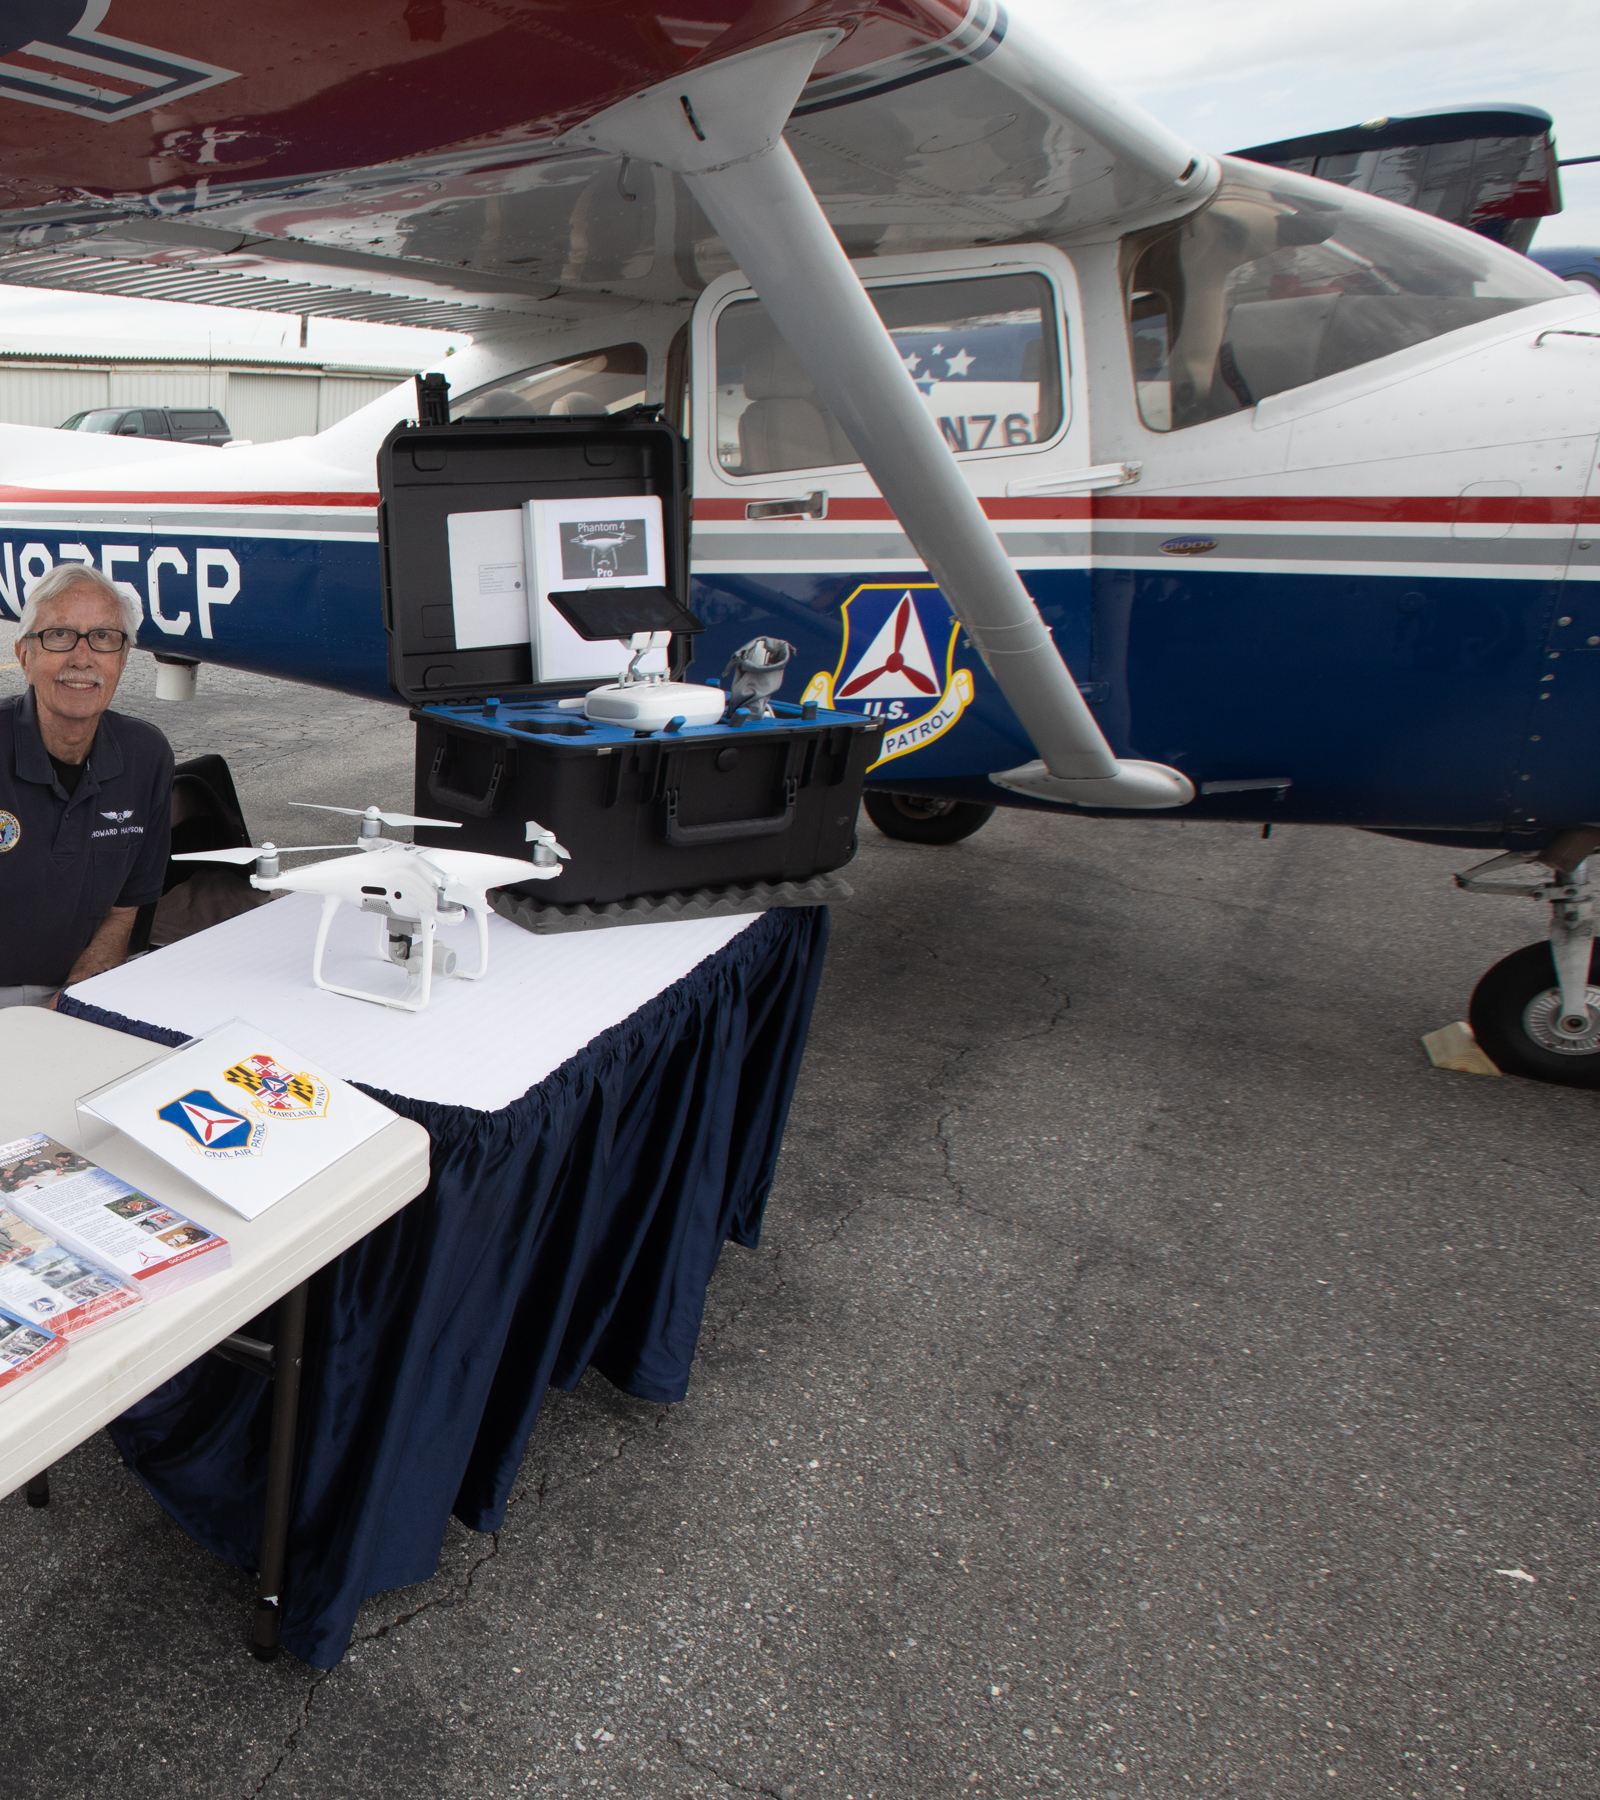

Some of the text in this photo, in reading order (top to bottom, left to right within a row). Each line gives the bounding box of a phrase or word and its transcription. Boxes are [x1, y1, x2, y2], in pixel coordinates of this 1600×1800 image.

[937, 413, 1039, 450] N76
[577, 522, 626, 533] Phantom 4
[597, 568, 613, 577] Pro
[863, 701, 909, 719] U.S.
[886, 710, 954, 753] PATROL
[91, 827, 118, 838] HOWARD
[315, 1086, 326, 1107] WING
[267, 1108, 317, 1118] MARYLAND
[5, 1137, 34, 1152] Patrol
[12, 1140, 49, 1156] Serving
[204, 1122, 265, 1159] CIVIL AIR PATROL
